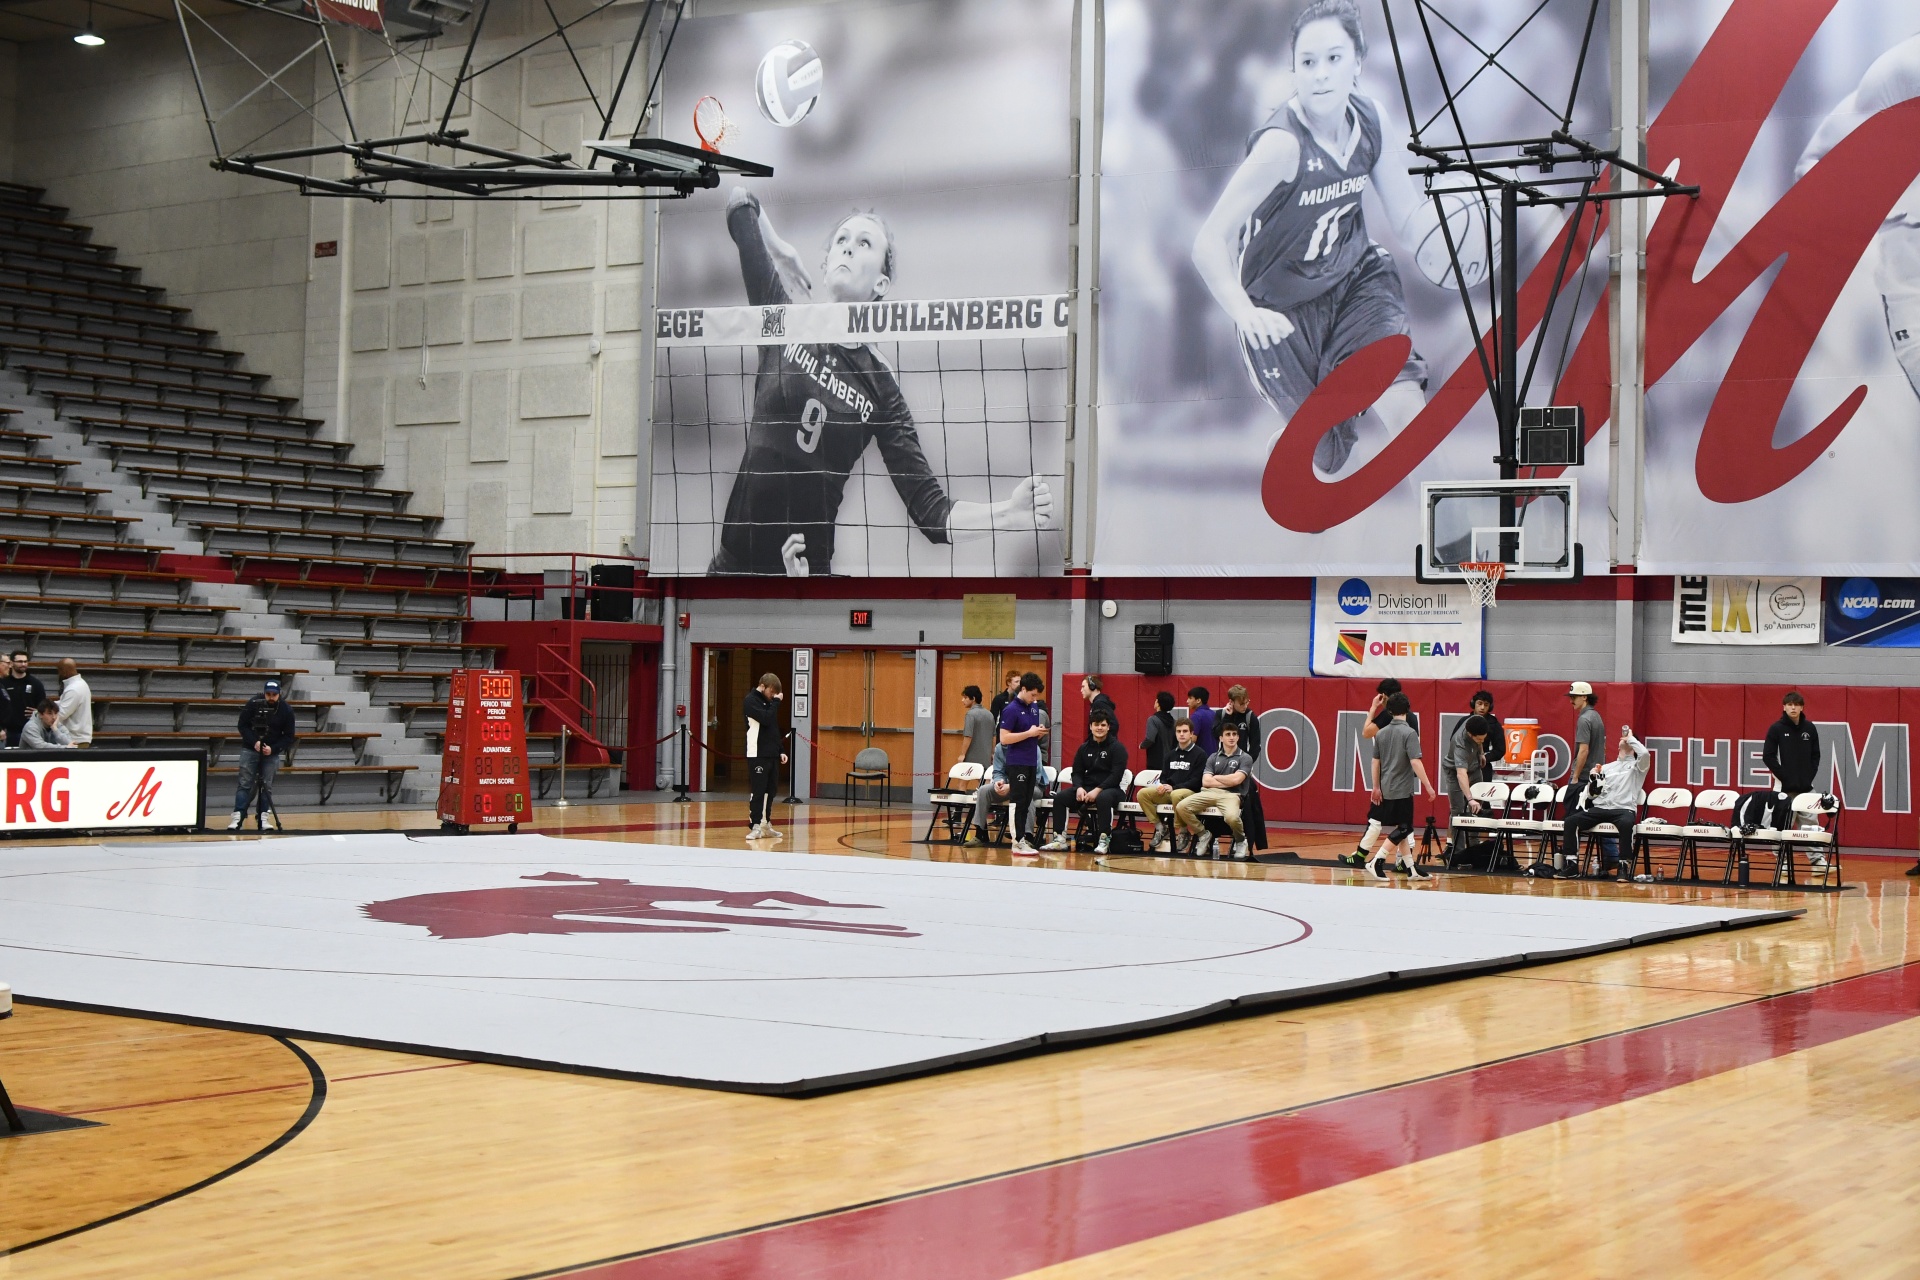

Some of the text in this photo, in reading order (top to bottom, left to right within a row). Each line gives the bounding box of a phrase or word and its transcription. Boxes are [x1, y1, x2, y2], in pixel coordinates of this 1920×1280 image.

[1304, 202, 1358, 261] 11
[657, 310, 703, 338] EGE
[847, 299, 1043, 334] MUHLENBERG
[784, 343, 874, 423] MUHLENBERG
[797, 398, 828, 453] 9
[1341, 596, 1371, 607] NCAA
[1378, 593, 1447, 609] Division III
[1679, 576, 1708, 634] TITLE
[1711, 579, 1752, 633] IX
[1842, 596, 1916, 609] NCAA.com
[853, 612, 868, 624] EXIT
[1776, 622, 1816, 630] Anniversary
[481, 678, 511, 697] 3:00
[481, 721, 512, 741] 0:00
[1510, 730, 1520, 742] G
[1645, 736, 1772, 788] THE
[5, 766, 70, 823] RG
